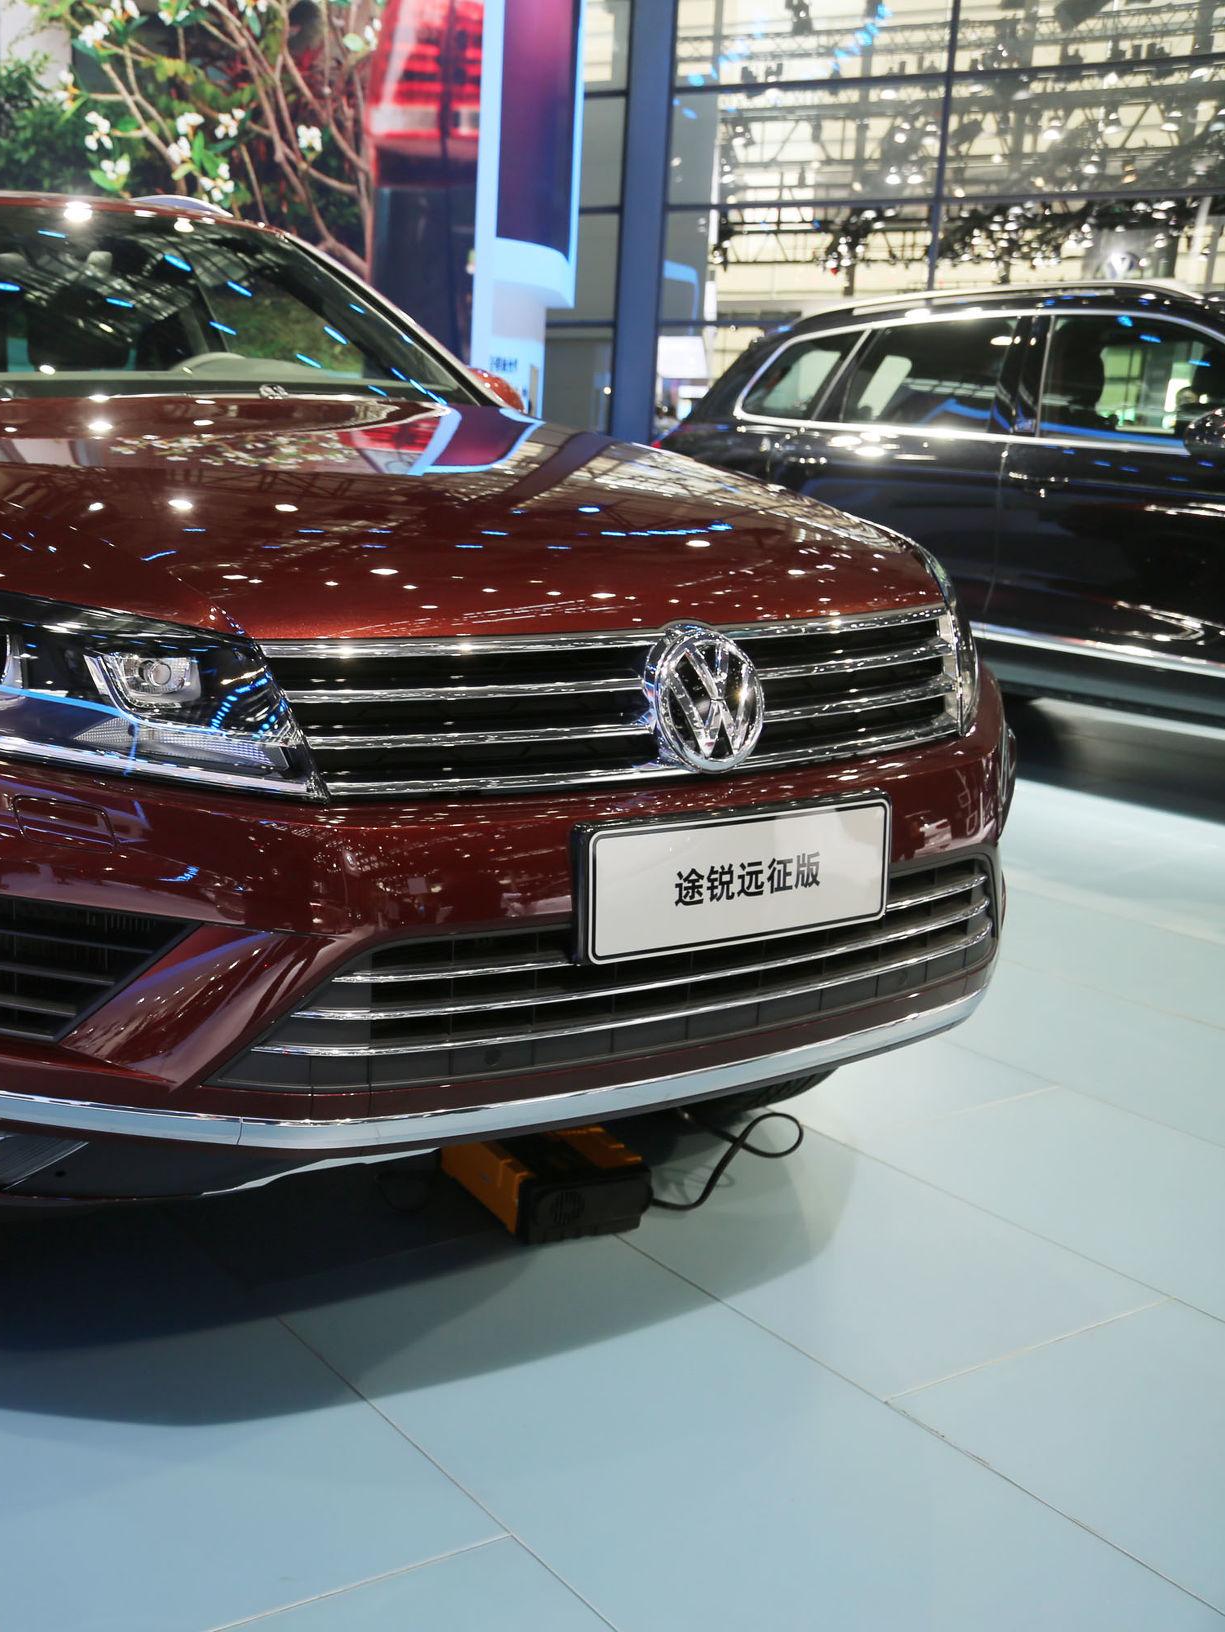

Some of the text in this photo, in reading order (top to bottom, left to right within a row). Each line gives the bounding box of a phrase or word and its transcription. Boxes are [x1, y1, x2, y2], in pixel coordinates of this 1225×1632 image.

[674, 852, 821, 907] 途锐远征版
